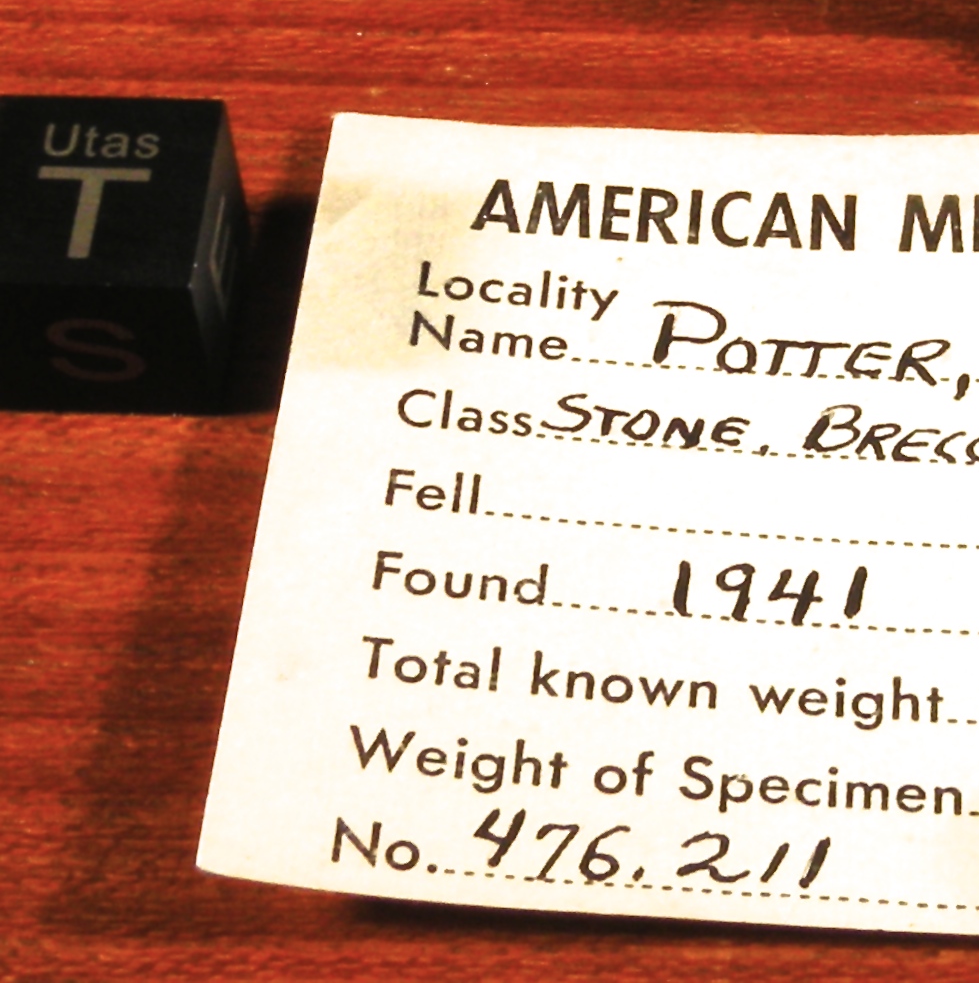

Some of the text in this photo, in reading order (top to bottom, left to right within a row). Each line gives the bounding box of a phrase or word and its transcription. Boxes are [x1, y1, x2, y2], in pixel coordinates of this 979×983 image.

[43, 123, 161, 159] Utas
[38, 166, 151, 259] T
[470, 178, 858, 251] AMERICAN
[418, 261, 619, 321] Locality
[46, 318, 146, 381] S
[408, 311, 568, 361] Name
[397, 389, 533, 437] Class
[385, 469, 481, 515] Fell
[372, 551, 549, 606] Found
[672, 560, 868, 626] 1941
[362, 636, 945, 730] Total known weight
[350, 724, 963, 816] Weight of Specimen
[331, 817, 438, 874] No.
